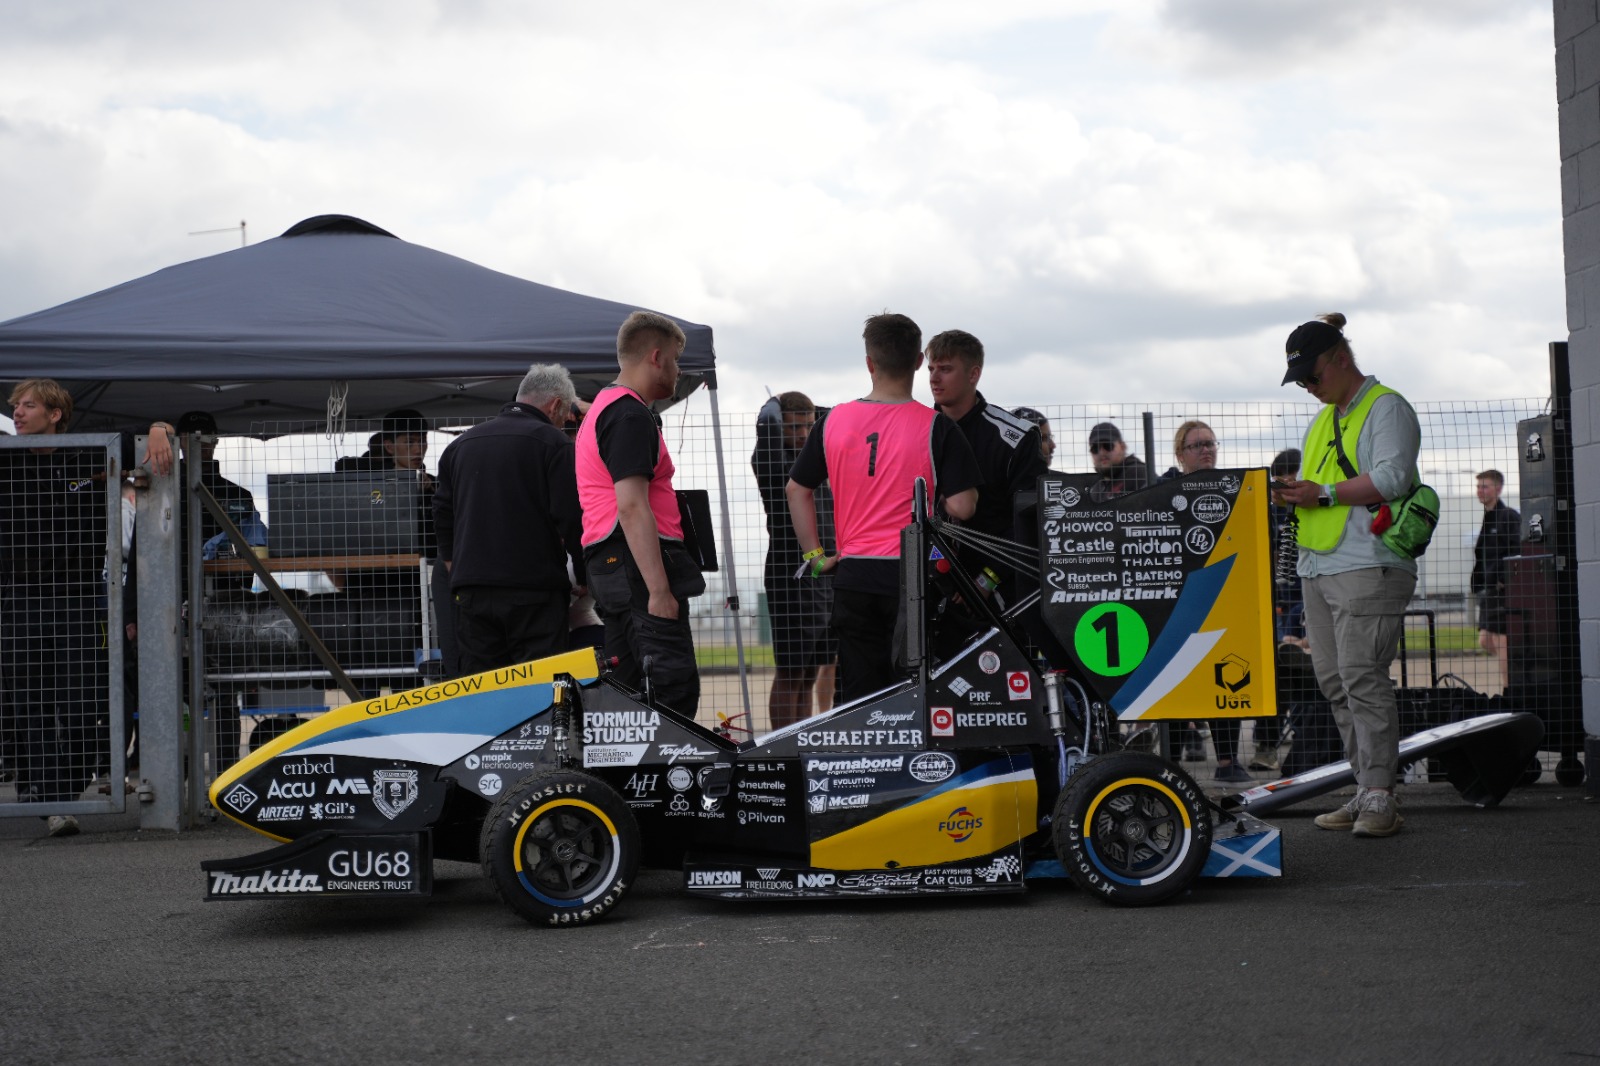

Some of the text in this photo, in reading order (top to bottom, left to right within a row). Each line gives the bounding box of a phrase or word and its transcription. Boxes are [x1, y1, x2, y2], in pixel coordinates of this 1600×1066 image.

[866, 432, 879, 477] 1
[1199, 502, 1223, 511] G&M
[1066, 510, 1114, 519] CIRRUS LOGIC
[1116, 509, 1175, 523] laserlines
[1062, 521, 1114, 533] HOWCO
[1063, 537, 1115, 553] Castle
[1122, 537, 1182, 555] midton
[1078, 556, 1115, 565] Engineering
[1122, 556, 1183, 567] THALES
[1067, 572, 1118, 583] Rotech
[1135, 570, 1183, 582] BATEMO
[1050, 587, 1179, 603] Arnold Clark
[1091, 611, 1120, 668] 1
[366, 664, 533, 715] GLASGOW UNI
[969, 692, 991, 702] PRF
[1216, 694, 1251, 709] UGR
[583, 711, 660, 727] FORMULA
[866, 710, 915, 726] Supagard
[956, 712, 1027, 727] REEPREG
[535, 725, 553, 736] SB
[583, 726, 657, 743] STUDENT
[798, 729, 923, 747] SCHAEFFLER
[482, 753, 512, 762] mapix
[659, 743, 719, 765] Taylor
[283, 757, 335, 775] embed
[482, 761, 534, 771] technologies
[737, 763, 785, 771] TESLA
[807, 755, 904, 771] Permabond
[918, 760, 946, 770] G&M
[746, 781, 786, 790] neutrelle
[833, 777, 875, 785] EVOLUTION
[829, 794, 869, 807] McGill
[257, 805, 305, 819] AIRTECH
[325, 802, 355, 815] Gil's
[698, 811, 726, 819] KeyShot
[748, 812, 786, 823] Pilvan
[938, 817, 983, 832] FUCHS
[328, 850, 410, 877] GU68
[688, 871, 742, 885] JEWSON
[797, 874, 835, 888] NXP
[924, 876, 973, 886] CAR CLUB
[327, 881, 412, 891] ENGINEERS TRUST
[745, 881, 794, 890] TRELLEBORG
